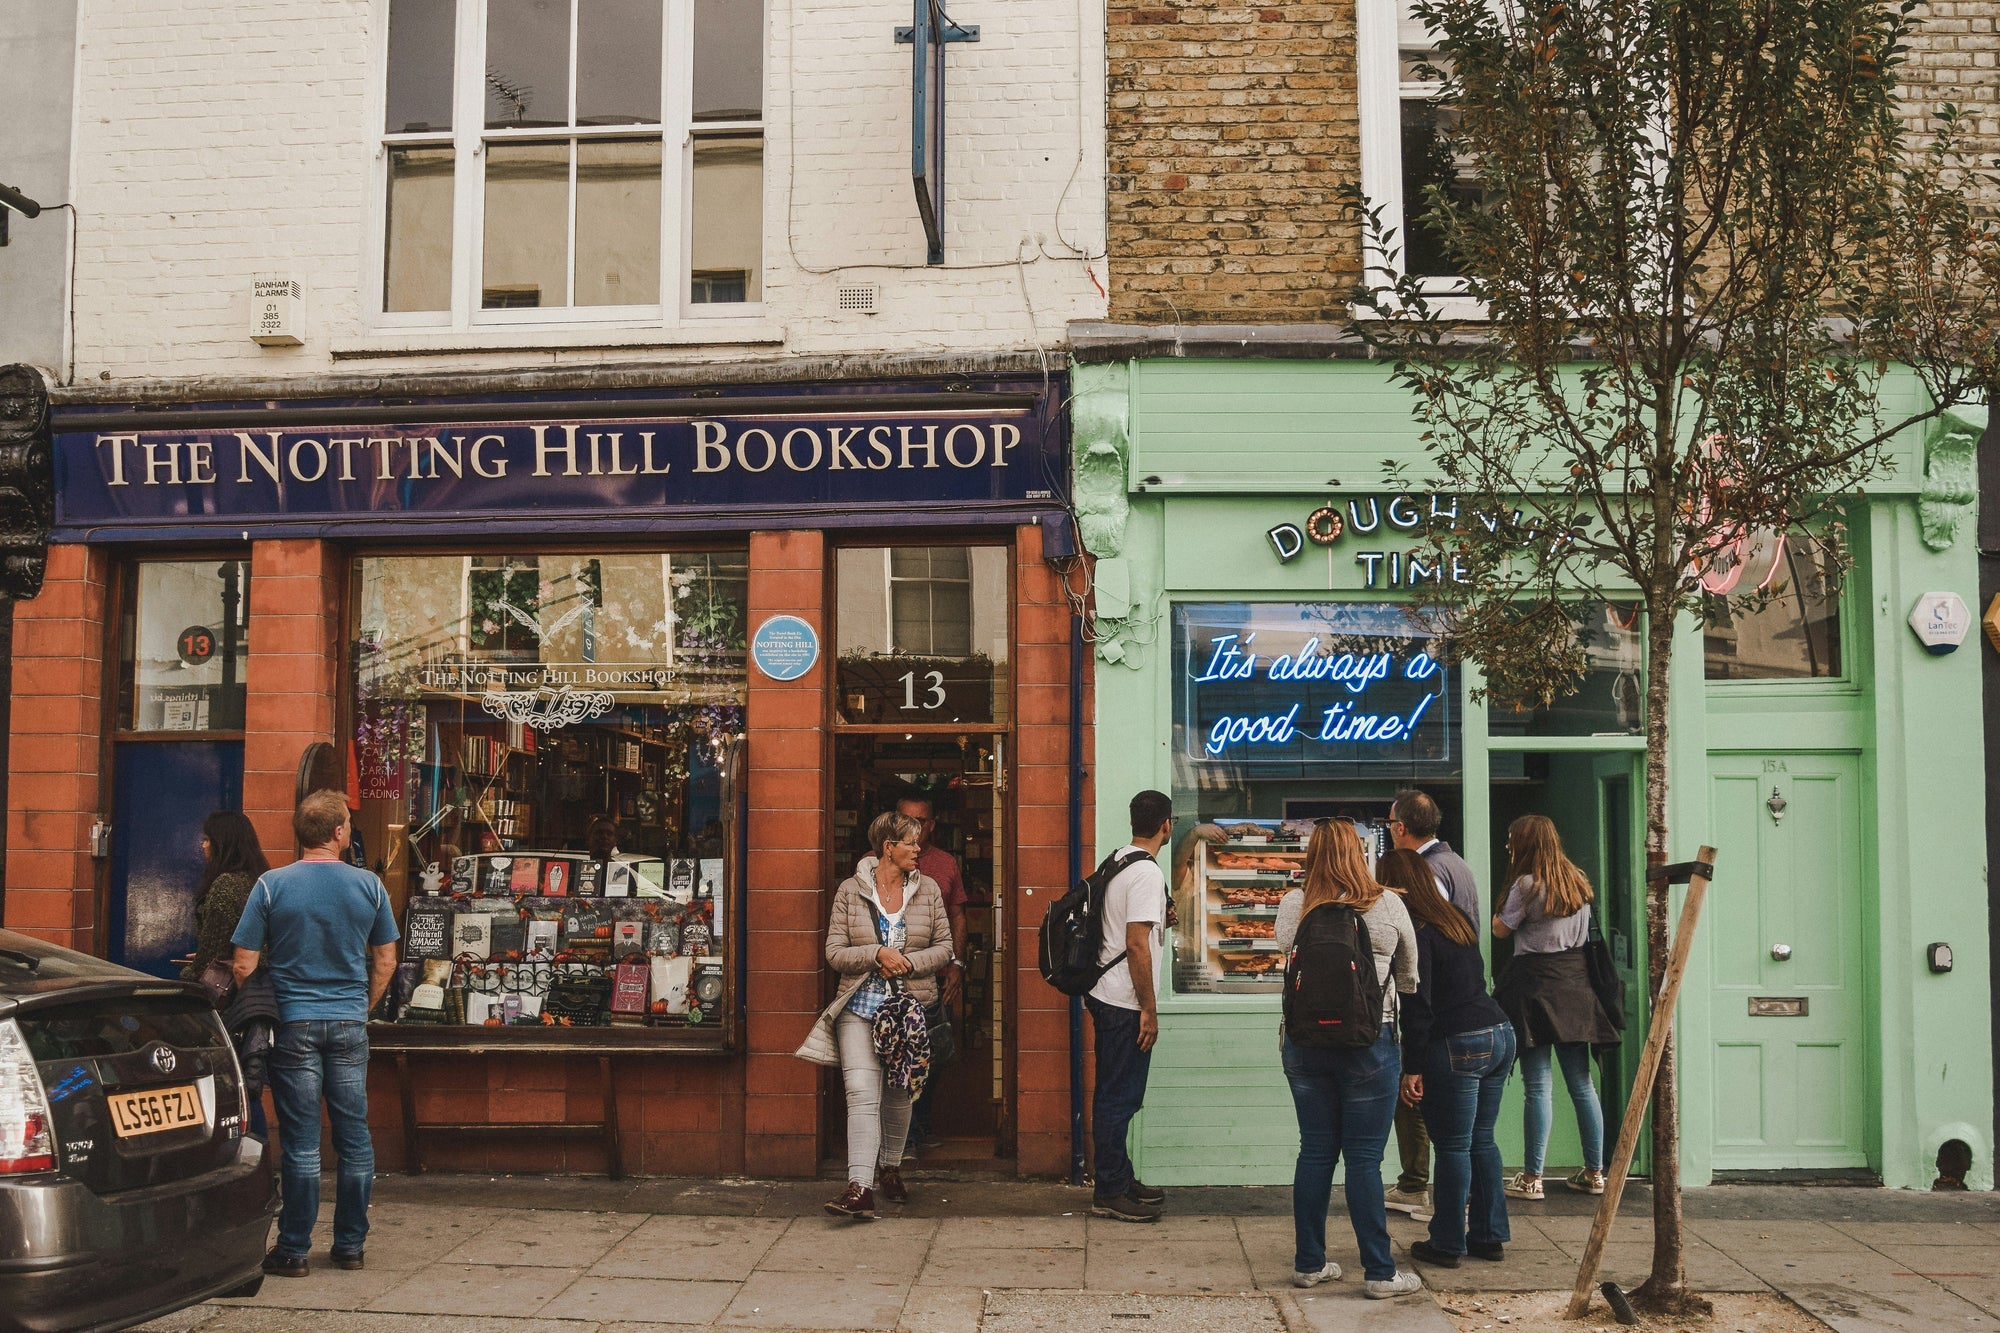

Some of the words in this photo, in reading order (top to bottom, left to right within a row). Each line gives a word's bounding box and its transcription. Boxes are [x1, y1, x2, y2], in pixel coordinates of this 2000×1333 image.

[254, 289, 288, 297] ALARMS
[96, 433, 217, 486] THE
[234, 431, 509, 484] NOTTING
[530, 424, 671, 477] HILL
[690, 421, 1021, 474] BOOKSHOP
[1354, 551, 1474, 589] TIME
[1928, 621, 1958, 630] LanTec
[184, 634, 210, 656] 13
[1195, 632, 1257, 682] It's
[1268, 636, 1391, 693] always
[1405, 652, 1437, 679] a
[422, 670, 458, 685] THE
[461, 670, 538, 684] NOTTING
[543, 670, 581, 684] HILL
[586, 669, 676, 684] BOOKSHOP
[898, 671, 946, 709] 13
[1206, 703, 1299, 753] good
[1320, 693, 1433, 740] time!
[1763, 759, 1787, 772] 15A
[371, 778, 386, 787] ON
[417, 937, 443, 946] MAGIC
[115, 1096, 163, 1131] LS56
[162, 1091, 196, 1124] FZJ
